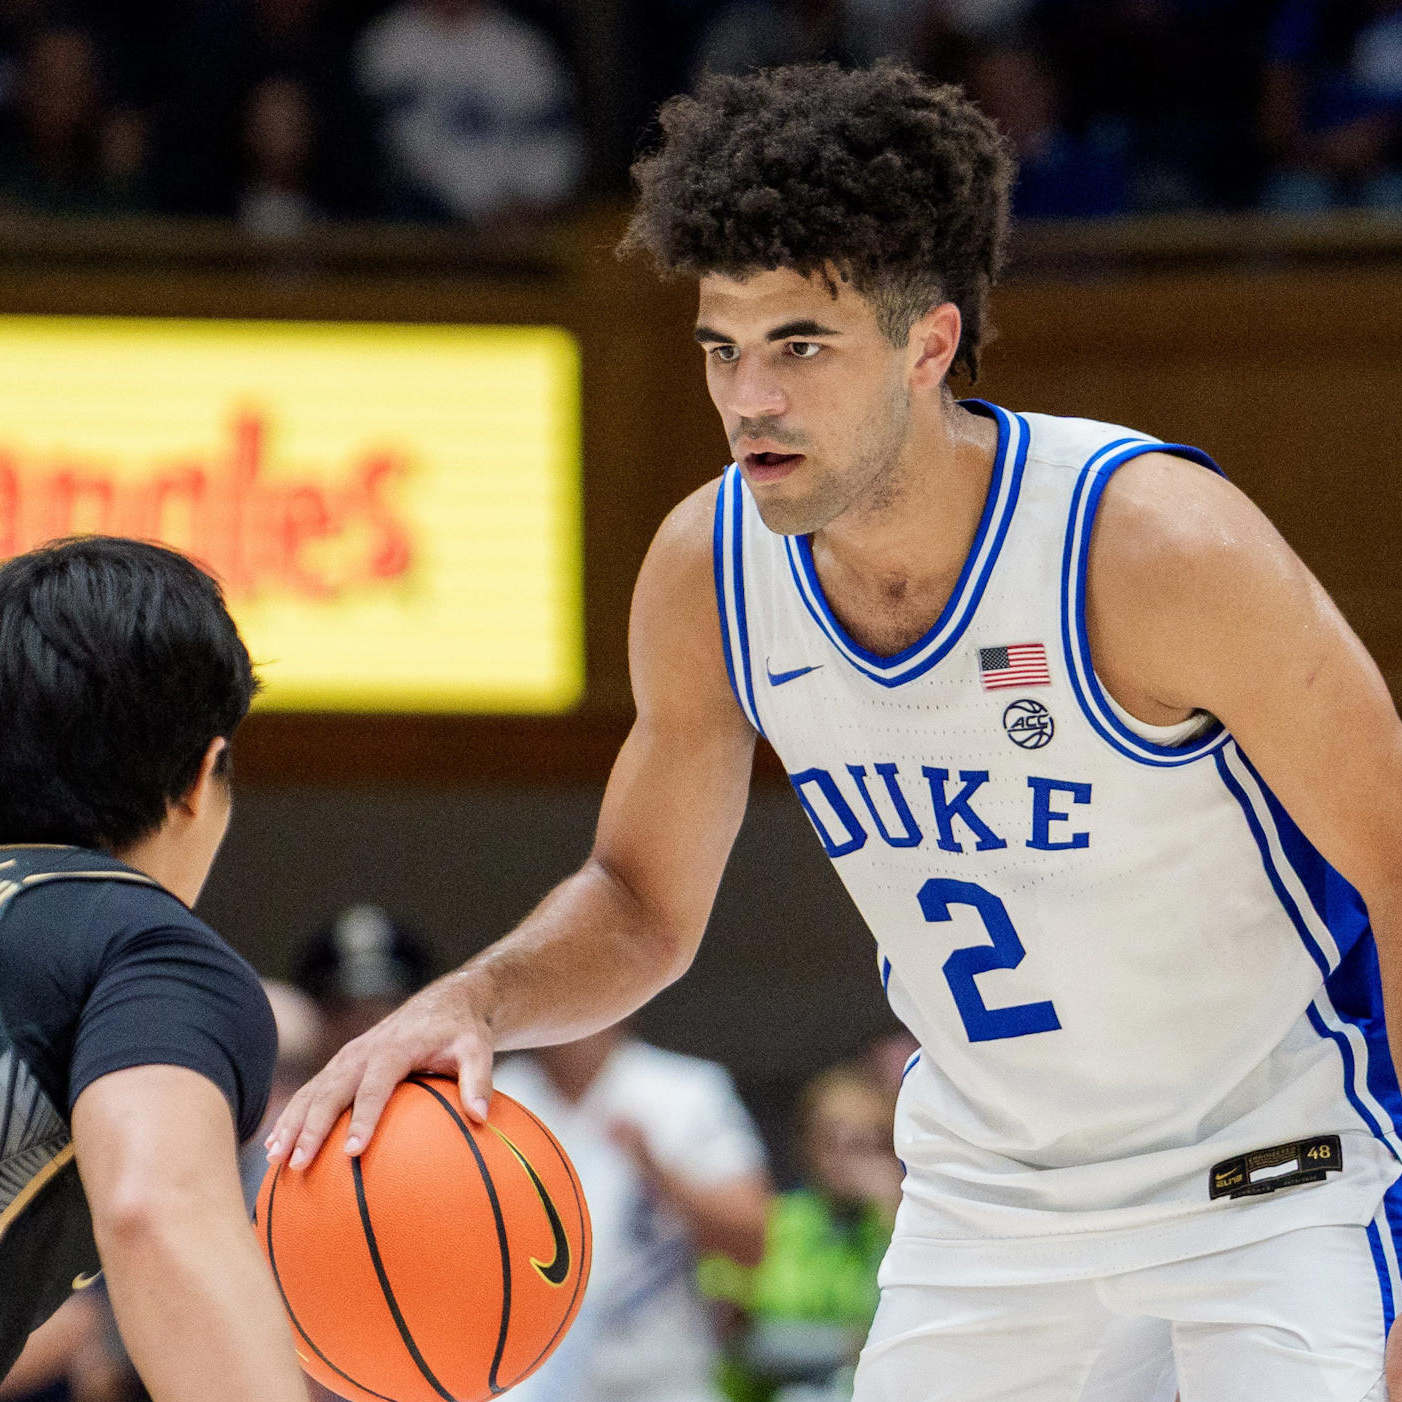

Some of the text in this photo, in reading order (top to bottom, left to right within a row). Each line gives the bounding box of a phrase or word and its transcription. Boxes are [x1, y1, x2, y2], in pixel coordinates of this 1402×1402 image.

[1010, 713, 1049, 730] ACC
[788, 762, 1092, 858] DUKE
[917, 878, 1062, 1042] 2
[1306, 1144, 1331, 1160] 48
